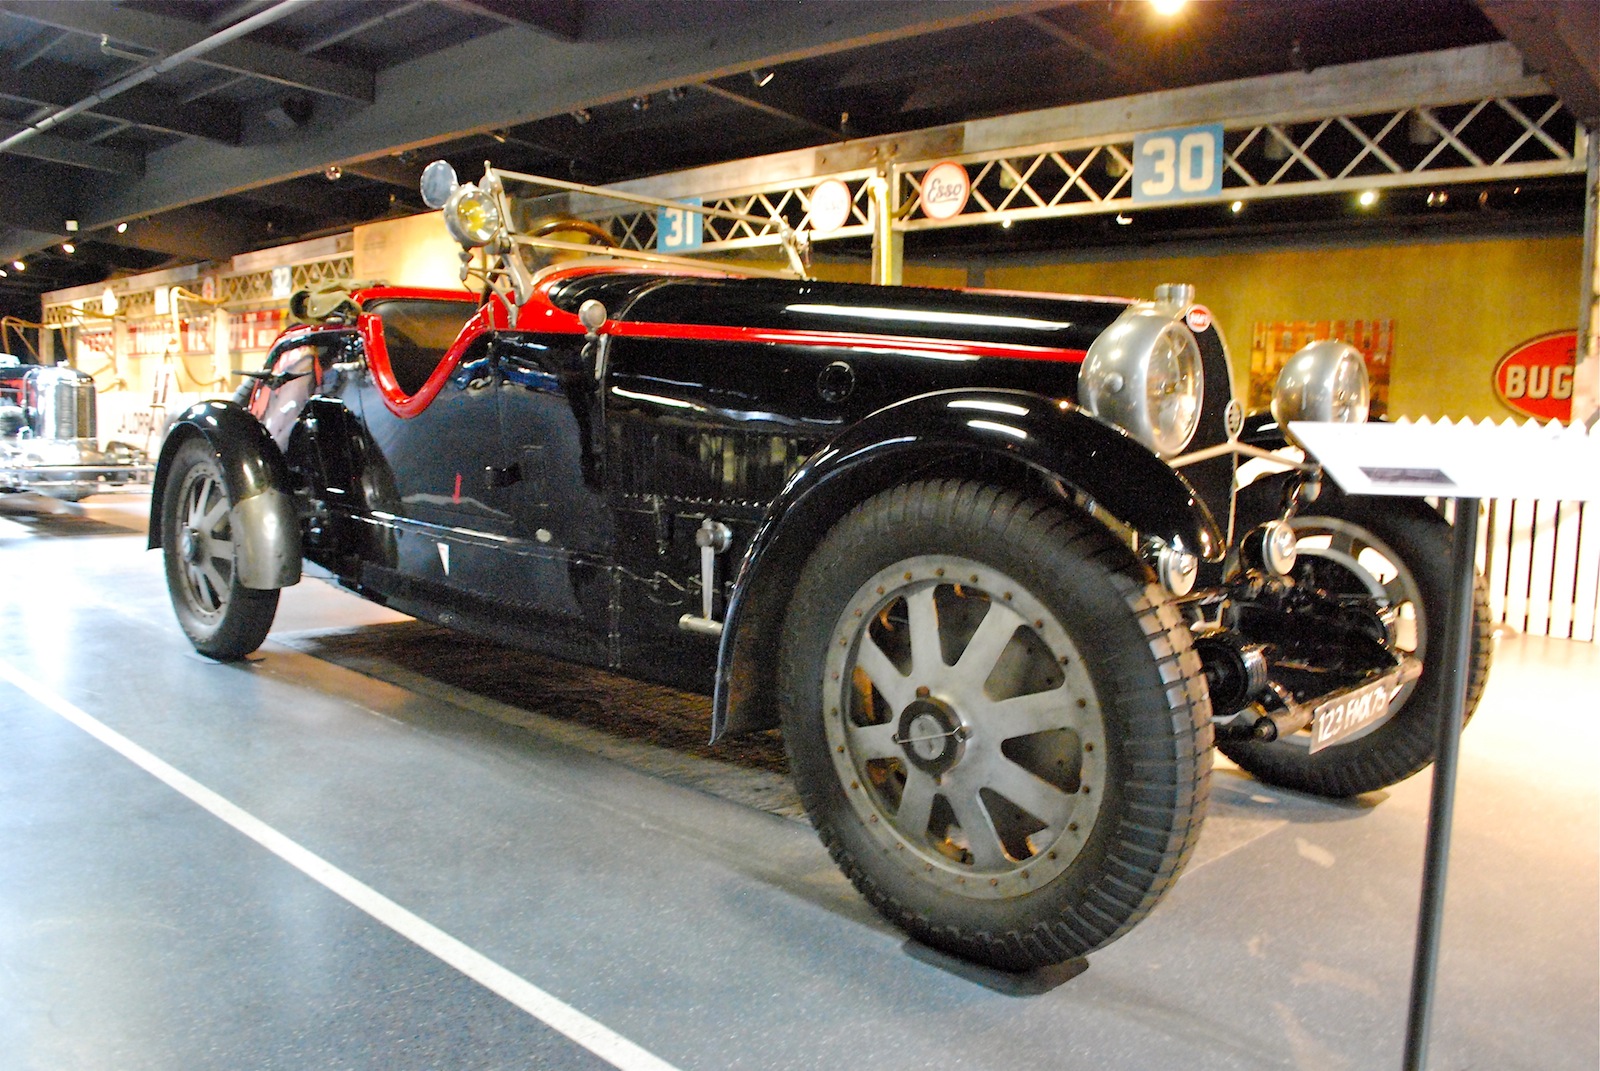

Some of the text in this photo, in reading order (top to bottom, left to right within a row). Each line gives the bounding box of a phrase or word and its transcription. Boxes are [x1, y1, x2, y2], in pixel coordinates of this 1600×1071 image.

[1141, 131, 1215, 196] 30
[927, 177, 962, 203] Esso
[665, 203, 694, 247] 31
[1505, 365, 1574, 400] BUG
[1318, 704, 1344, 743] 123
